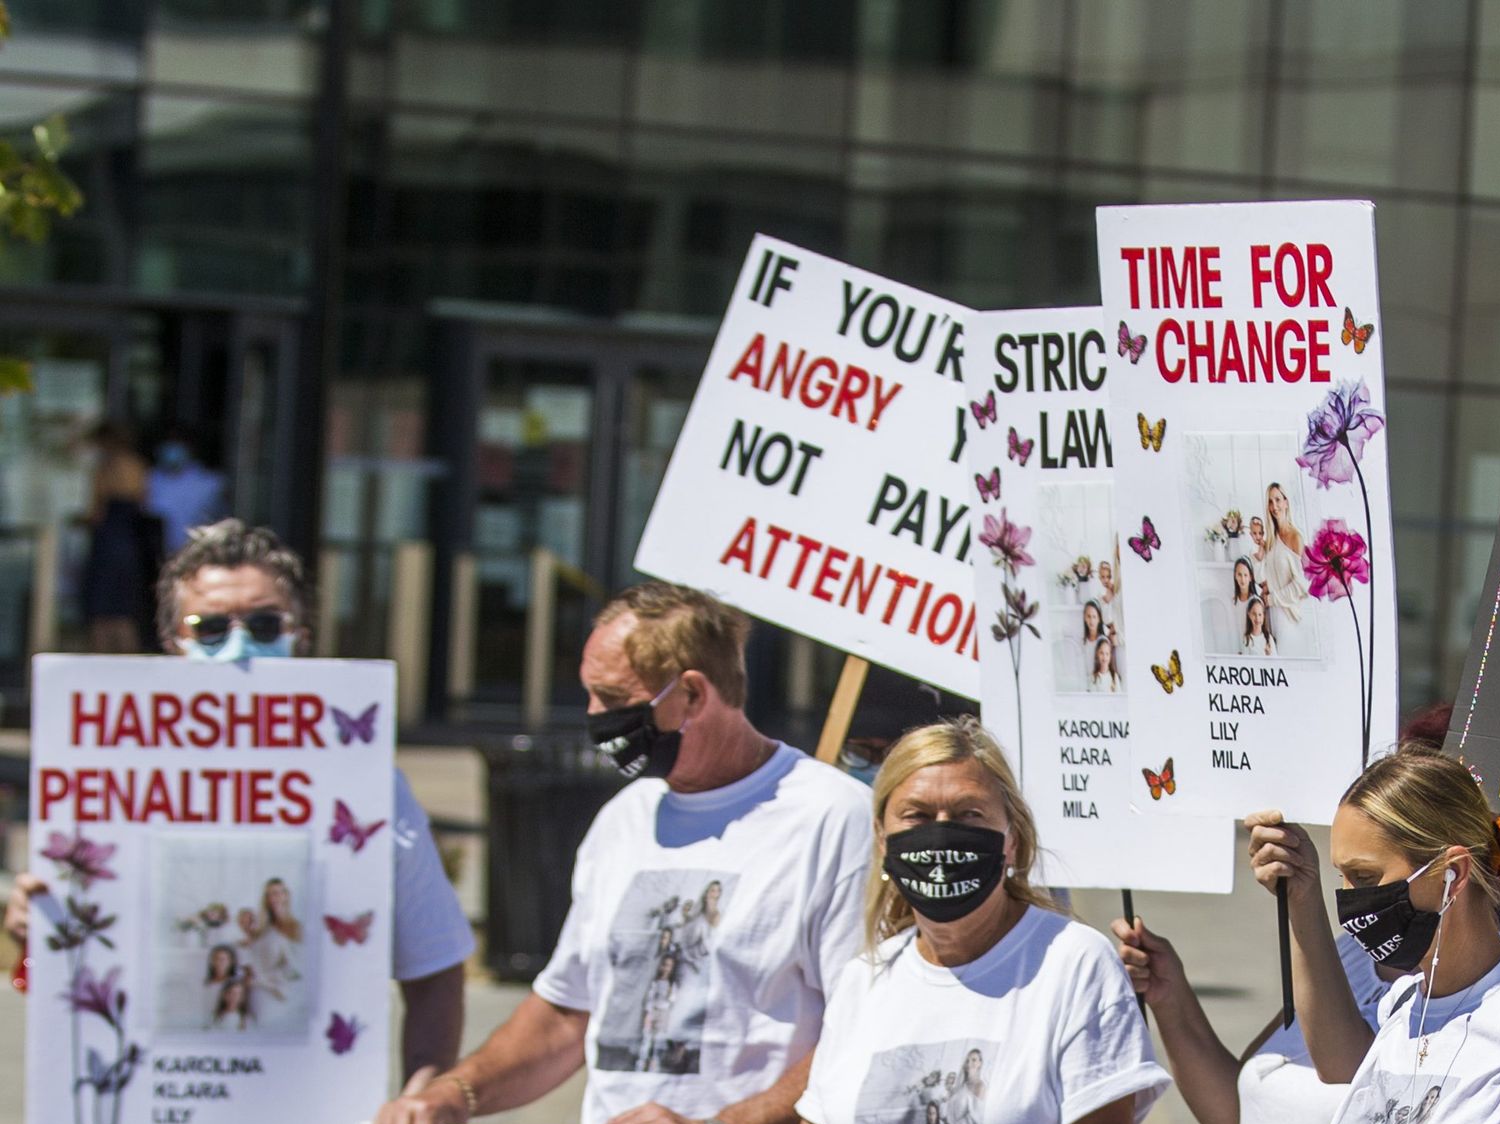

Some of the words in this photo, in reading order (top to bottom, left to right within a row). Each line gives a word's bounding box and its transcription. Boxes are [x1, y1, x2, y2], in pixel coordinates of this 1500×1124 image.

[749, 249, 799, 307] IF
[1121, 246, 1224, 309] TIME
[1250, 243, 1337, 308] FOR
[1155, 319, 1332, 384] CHANGE
[727, 333, 903, 432] ANGRY
[719, 419, 824, 497] NOT
[1206, 664, 1289, 687] KAROLINA
[1209, 693, 1265, 714] KLARA
[71, 692, 325, 748] HARSHER
[1210, 721, 1239, 741] LILY
[1060, 746, 1112, 766] KLARA
[1212, 749, 1251, 770] MILA
[1062, 773, 1089, 792] LILY
[39, 769, 314, 826] PENALTIES
[1063, 800, 1099, 819] MILA
[929, 864, 946, 883] 4
[152, 1054, 265, 1076] KAROLINA
[152, 1080, 231, 1100] KLARA
[151, 1106, 194, 1124] LILY
